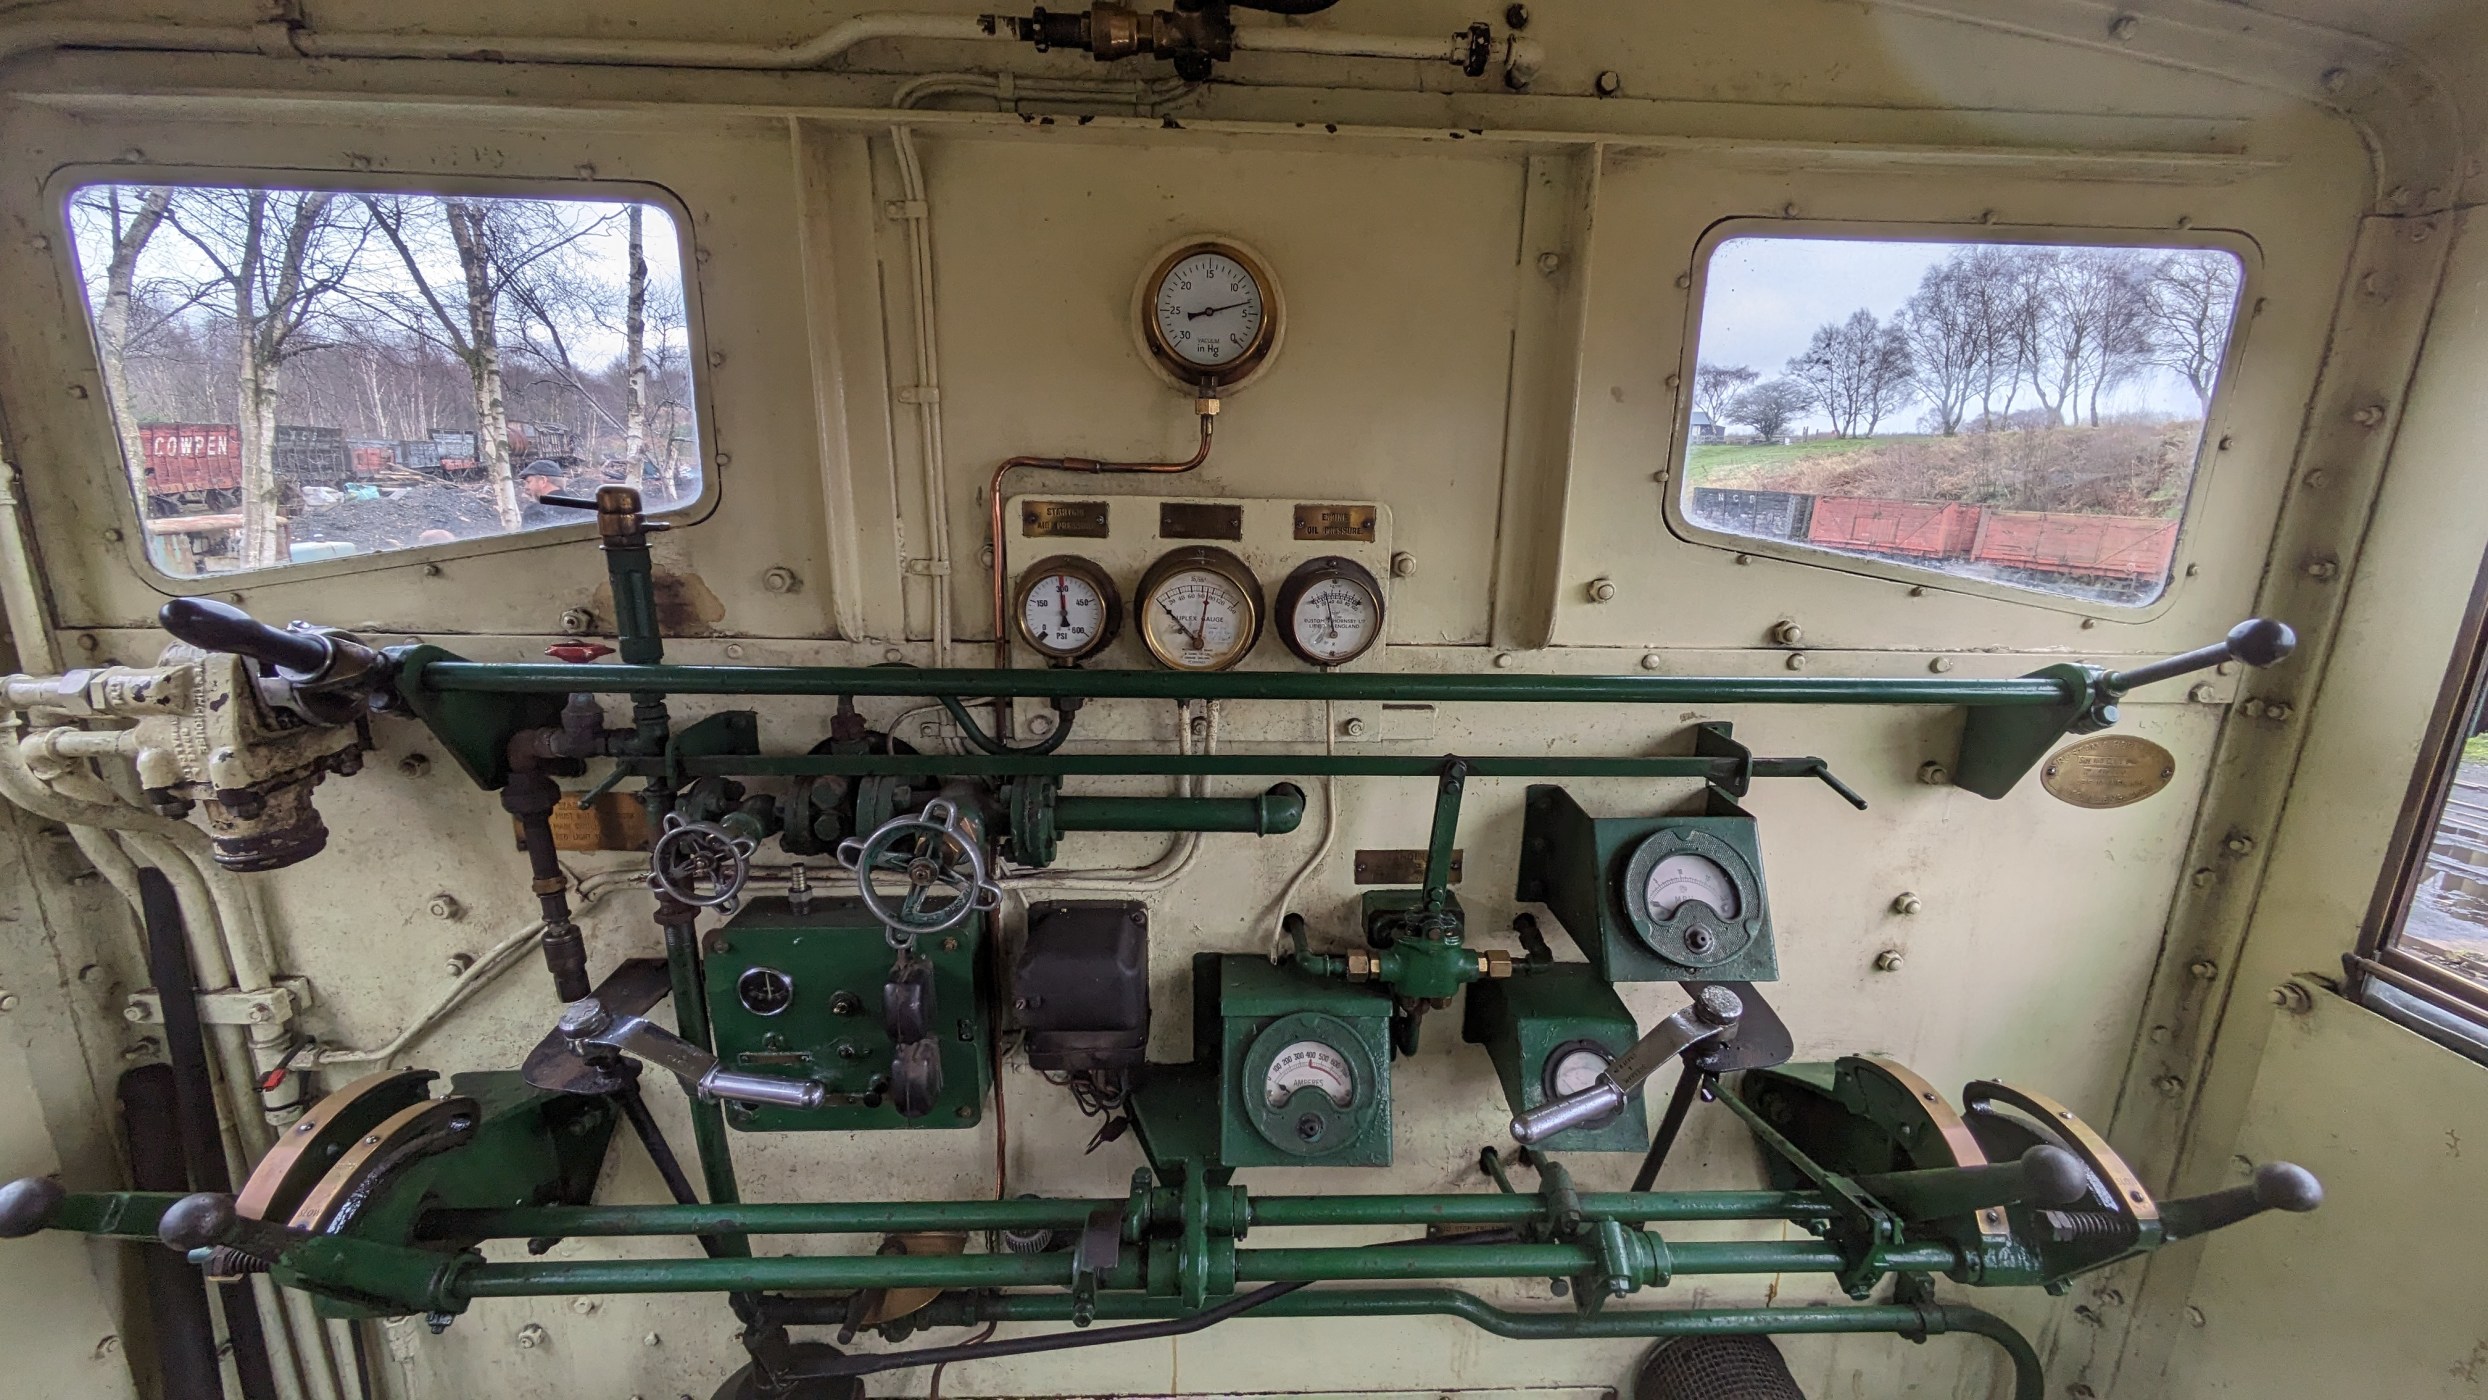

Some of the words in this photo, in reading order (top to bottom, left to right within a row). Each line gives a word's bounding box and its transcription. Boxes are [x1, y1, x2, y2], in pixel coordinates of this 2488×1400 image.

[1206, 269, 1215, 279] 15
[1180, 281, 1192, 290] 20
[1230, 282, 1239, 292] 10
[1170, 306, 1181, 315] 25
[1241, 309, 1248, 318] 5
[1180, 330, 1191, 340] 30
[1230, 333, 1236, 341] 0
[1197, 344, 1205, 353] in
[1207, 344, 1219, 357] Hg
[154, 436, 228, 457] COWPEN
[1306, 526, 1319, 535] OIL
[1056, 585, 1069, 593] 300
[1036, 599, 1048, 607] 150
[1076, 598, 1089, 606] 450
[1056, 632, 1068, 640] PSI
[1293, 1051, 1305, 1061] 300
[1305, 1051, 1316, 1059] 400
[1318, 1053, 1330, 1062] 500
[1282, 1056, 1293, 1066] 200
[1273, 1063, 1283, 1073] 100
[1293, 1079, 1324, 1087] AMPERES
